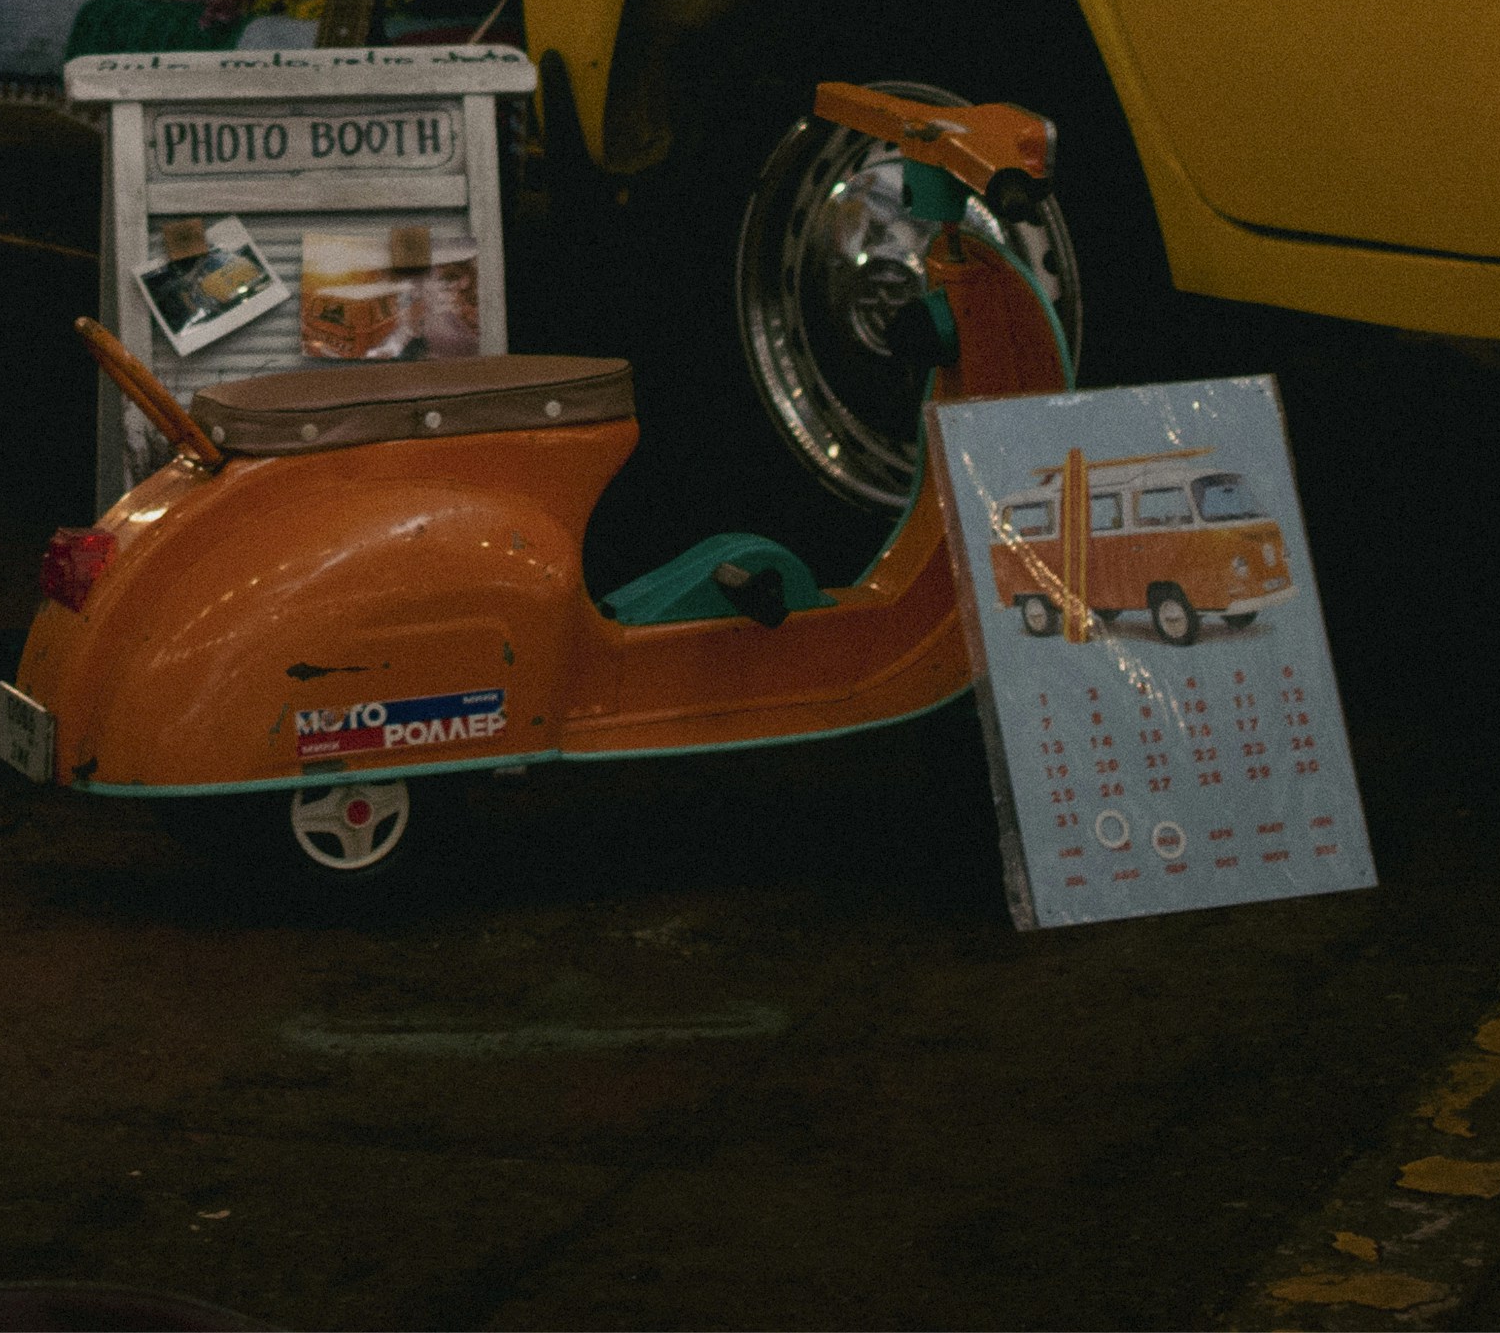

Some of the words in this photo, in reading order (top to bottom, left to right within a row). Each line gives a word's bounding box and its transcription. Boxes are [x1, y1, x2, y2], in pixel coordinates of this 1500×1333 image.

[163, 121, 288, 166] PHOTO
[311, 118, 441, 158] BOOTH
[295, 701, 389, 735] МОТО
[383, 711, 508, 749] РОЛЛЕР
[1042, 717, 1052, 730] 7
[1281, 688, 1304, 703] 12
[1041, 740, 1065, 755] 13
[1090, 735, 1113, 749] 14
[1139, 730, 1163, 744] 15
[1236, 717, 1258, 731] 17
[1285, 712, 1309, 726] 18
[1046, 764, 1069, 778] 19
[1096, 759, 1119, 774] 20
[1145, 754, 1169, 768] 21
[1194, 747, 1217, 762] 22
[1243, 742, 1266, 756] 23
[1291, 736, 1316, 751] 24
[1051, 788, 1075, 803] 25
[1100, 783, 1124, 798] 26
[1149, 777, 1171, 792] 27
[1199, 771, 1222, 786] 28
[1247, 765, 1271, 780] 29
[1296, 760, 1319, 774] 30
[1056, 813, 1078, 828] 31
